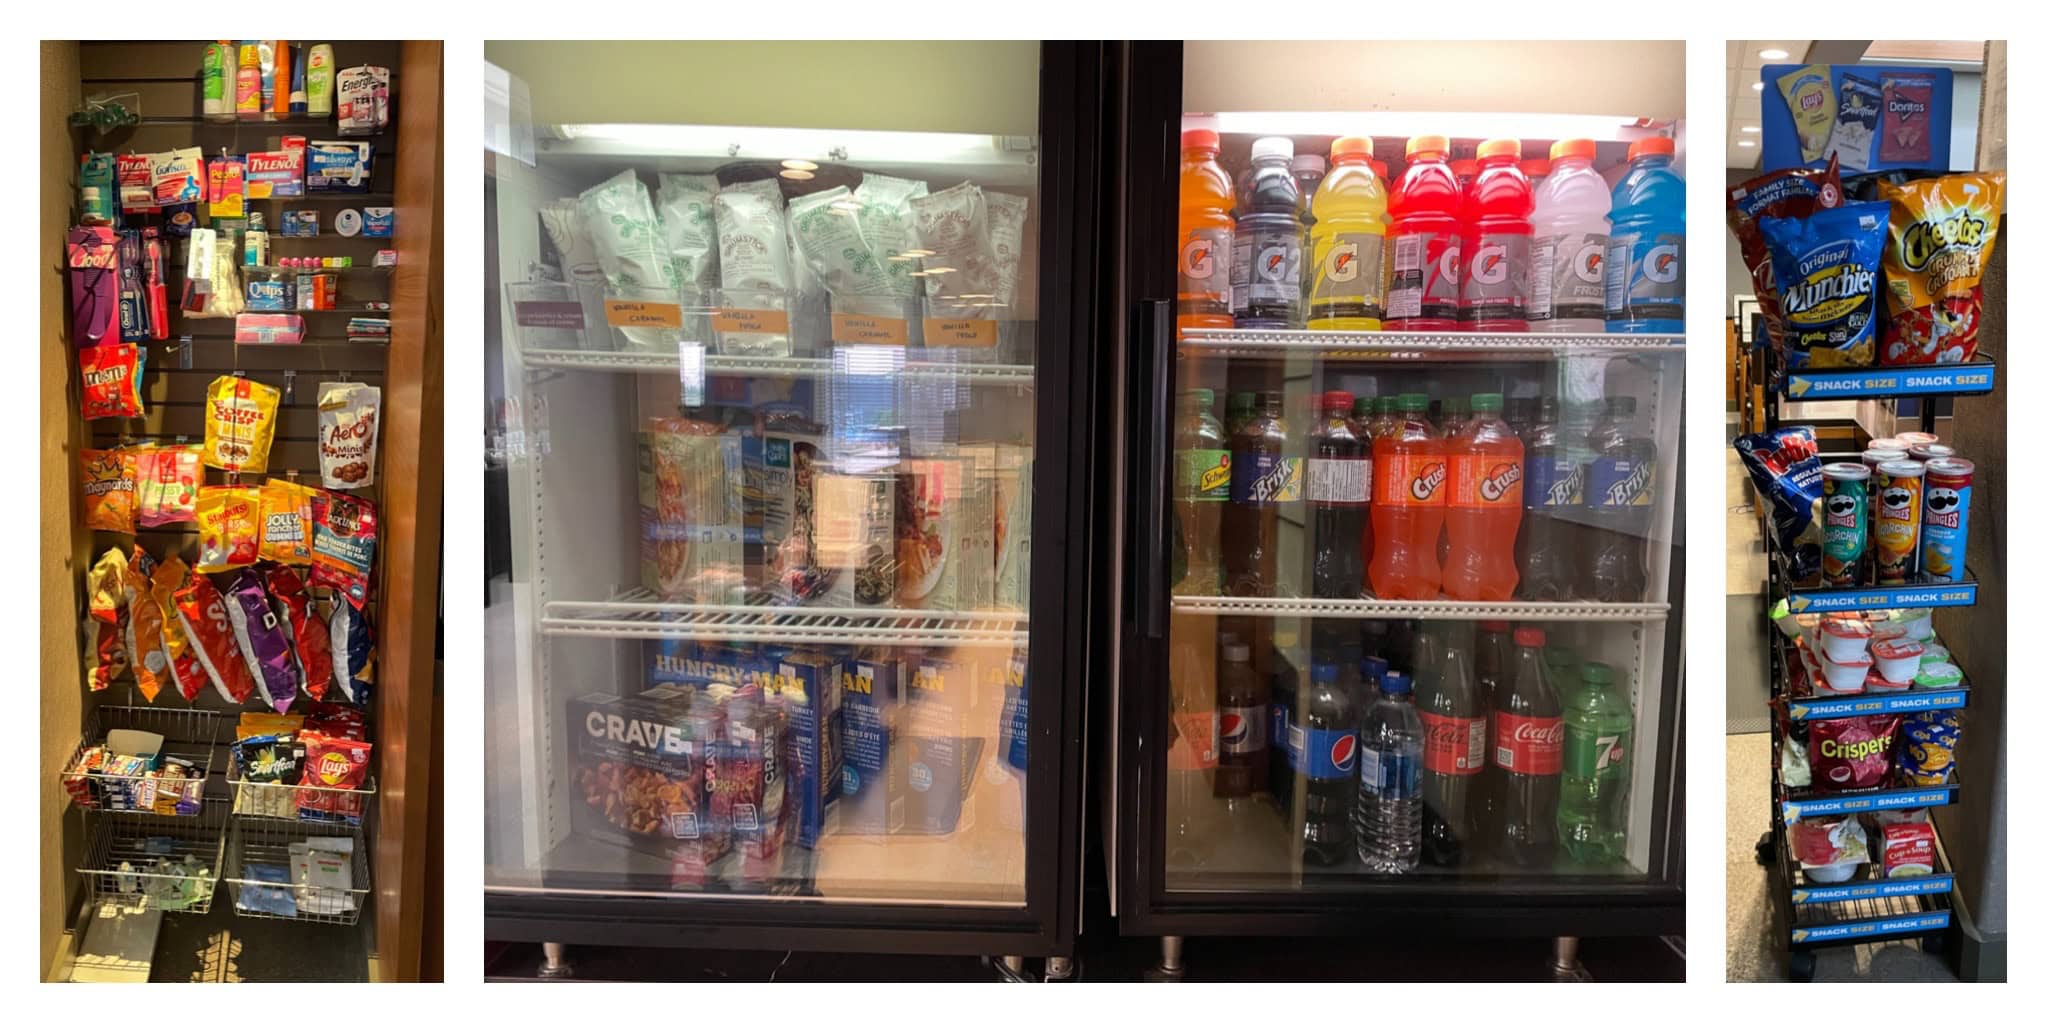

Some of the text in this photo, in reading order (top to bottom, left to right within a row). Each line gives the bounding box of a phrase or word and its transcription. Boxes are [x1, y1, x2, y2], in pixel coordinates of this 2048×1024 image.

[1889, 101, 1925, 113] Doritos
[250, 158, 300, 172] TYLENOL
[1753, 179, 1785, 199] FAMILY
[1904, 212, 1984, 269] Cheetos
[1325, 242, 1358, 282] G
[1471, 245, 1507, 285] G
[1642, 244, 1678, 284] G
[1800, 245, 1849, 276] Original
[1783, 264, 1876, 314] Munchies
[1814, 374, 1987, 391] SNACK SIZE SNACK SIZE
[1252, 456, 1294, 501] Brisk
[1410, 462, 1446, 501] Crush
[1481, 462, 1521, 502] Crush
[1608, 460, 1650, 505] Brisk
[267, 513, 300, 527] JOLLY
[1925, 509, 1960, 529] PRINGLES
[1813, 591, 1970, 607] SNACK SIZE SNACK SIZE
[1811, 696, 1961, 714] SNACK SIZE SNACK SIZE
[586, 711, 693, 755] CRAVE
[764, 725, 775, 785] CRAVE
[1802, 793, 1944, 812] SNACK SIZE SNACK SIZE
[1812, 881, 1948, 899] SNACK SIZE SNACK SIZE
[1812, 918, 1945, 937] SNACK SIZE SNACK SIZE
